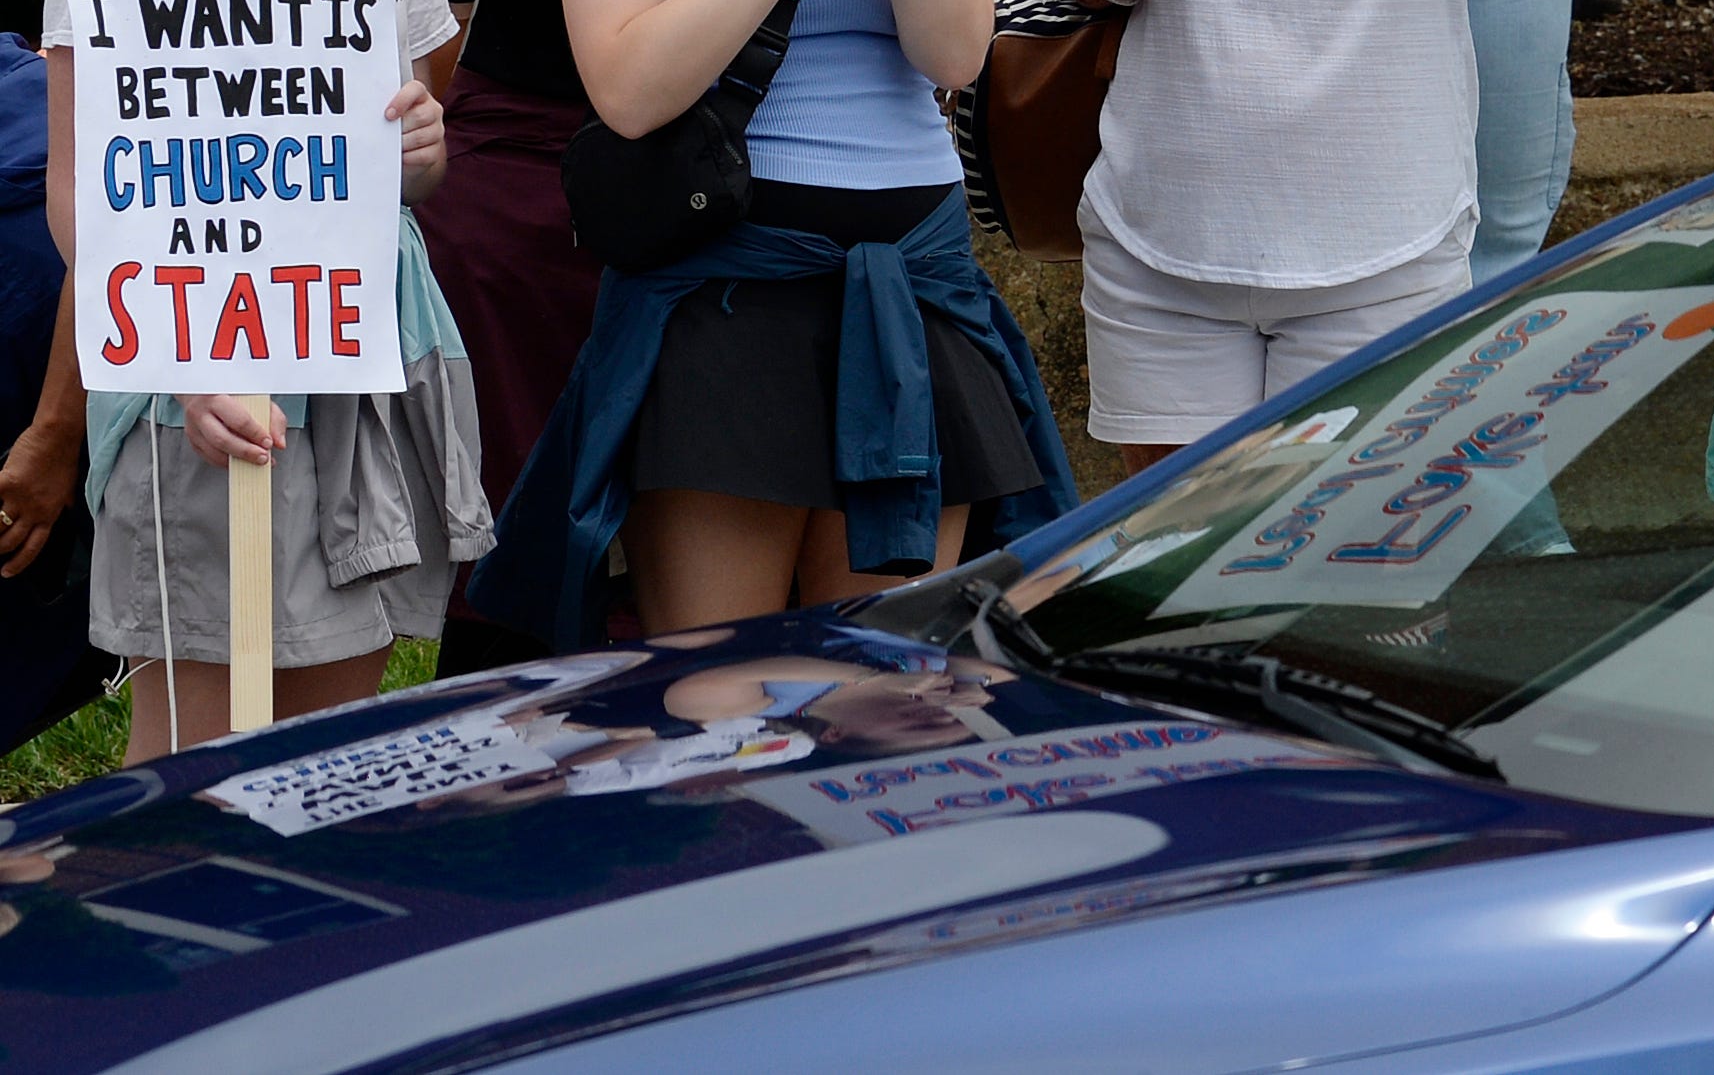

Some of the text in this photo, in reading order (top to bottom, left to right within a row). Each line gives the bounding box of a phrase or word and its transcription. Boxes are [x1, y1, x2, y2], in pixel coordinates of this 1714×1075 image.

[115, 66, 345, 120] BETWEEN
[103, 133, 349, 212] CHURCH
[168, 217, 263, 255] AND
[101, 260, 362, 366] STATE
